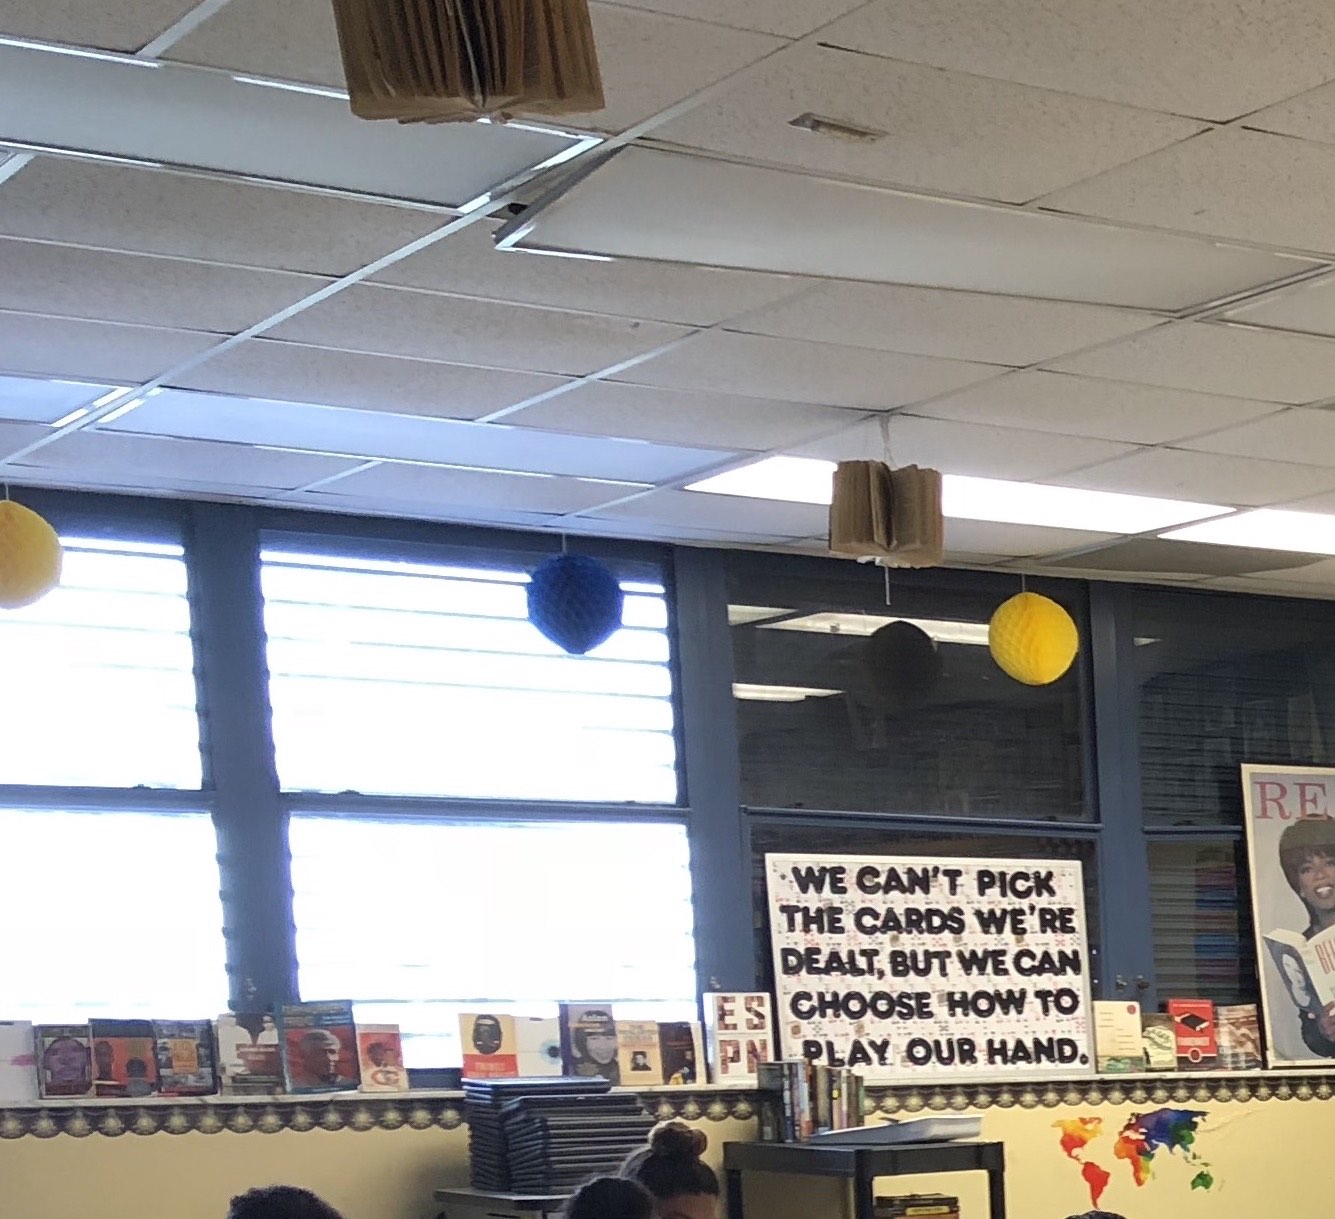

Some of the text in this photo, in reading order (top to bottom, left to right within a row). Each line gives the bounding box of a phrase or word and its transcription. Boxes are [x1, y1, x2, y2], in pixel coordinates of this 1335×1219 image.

[791, 865, 1057, 900] WE CAN'T PICK
[779, 904, 1076, 936] THE CARDS WE'RE
[780, 946, 1082, 980] DEALT, BUT WE CAN
[789, 987, 1081, 1020] CHOOSE HOW TO
[802, 1037, 1089, 1067] PLAY OUR HAND.
